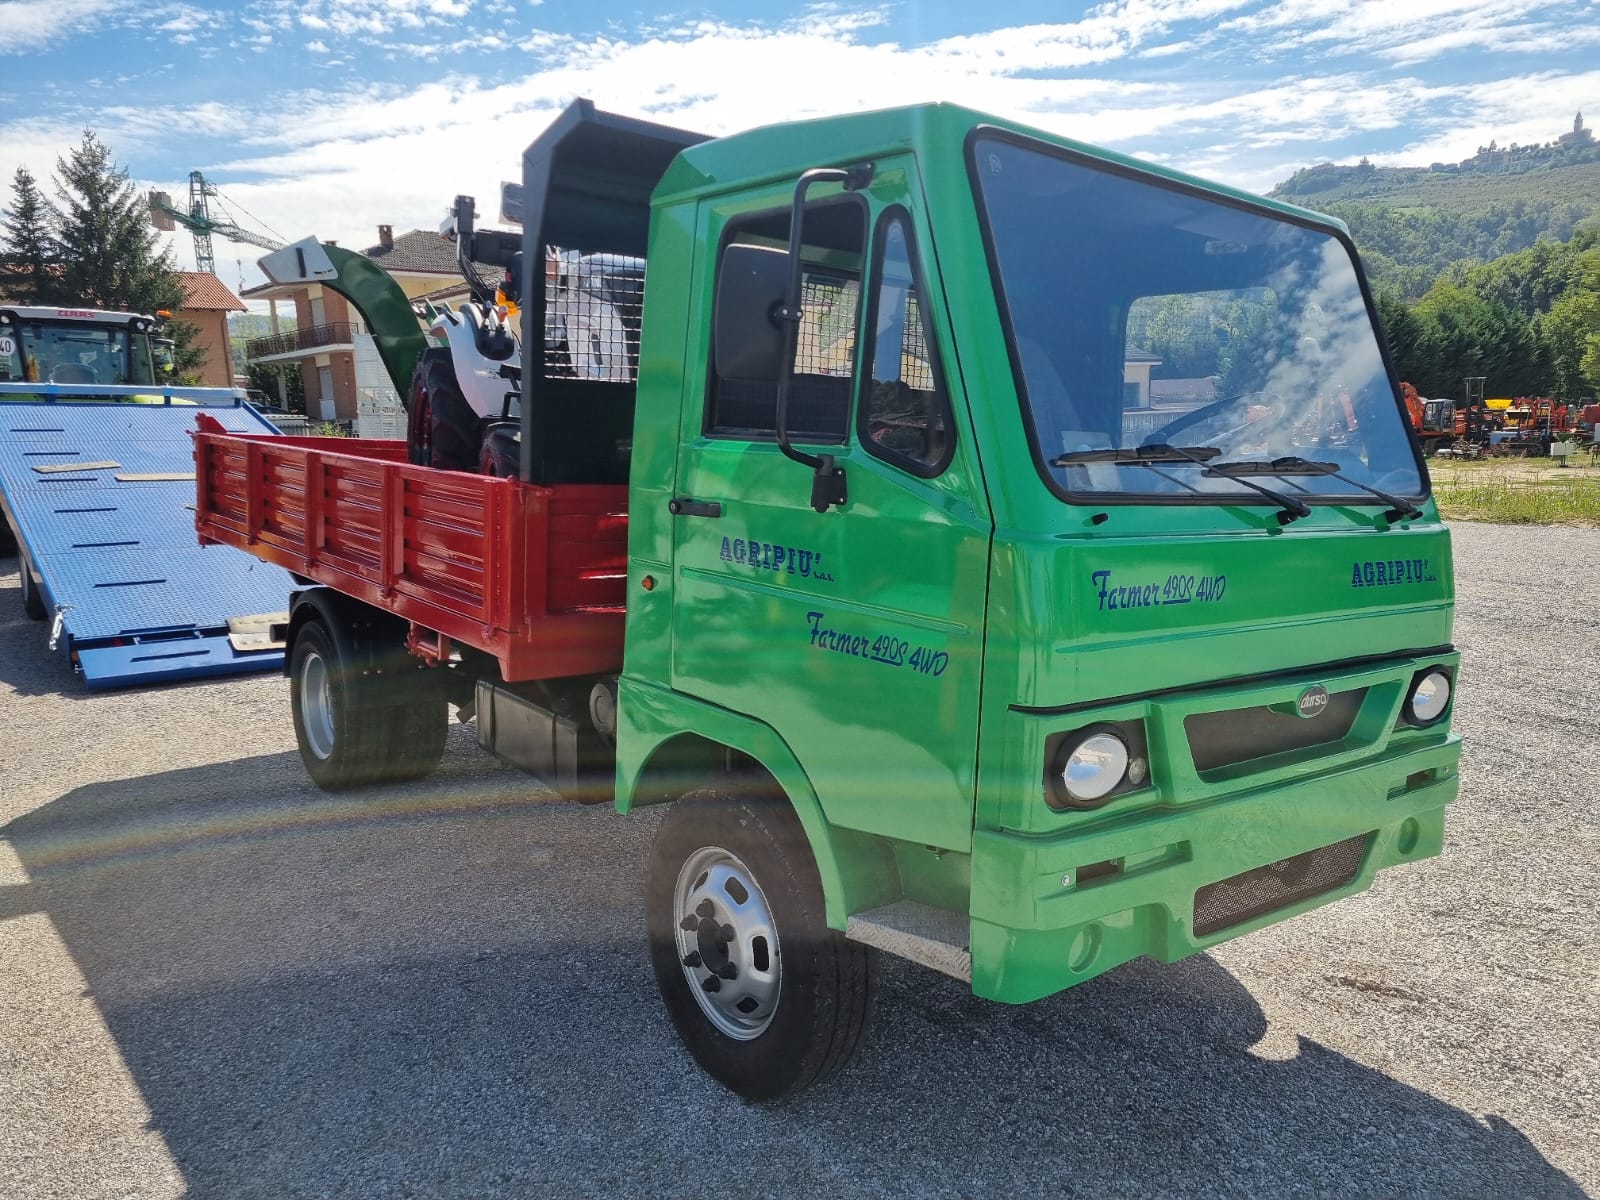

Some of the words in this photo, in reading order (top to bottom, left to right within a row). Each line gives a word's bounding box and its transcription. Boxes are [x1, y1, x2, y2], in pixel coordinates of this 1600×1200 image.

[1091, 570, 1160, 611] Farmer
[1162, 575, 1195, 605] 490S
[1195, 575, 1226, 603] 4WD
[806, 611, 870, 658] Farmer
[870, 635, 909, 666] 490S
[908, 646, 949, 677] 4WD
